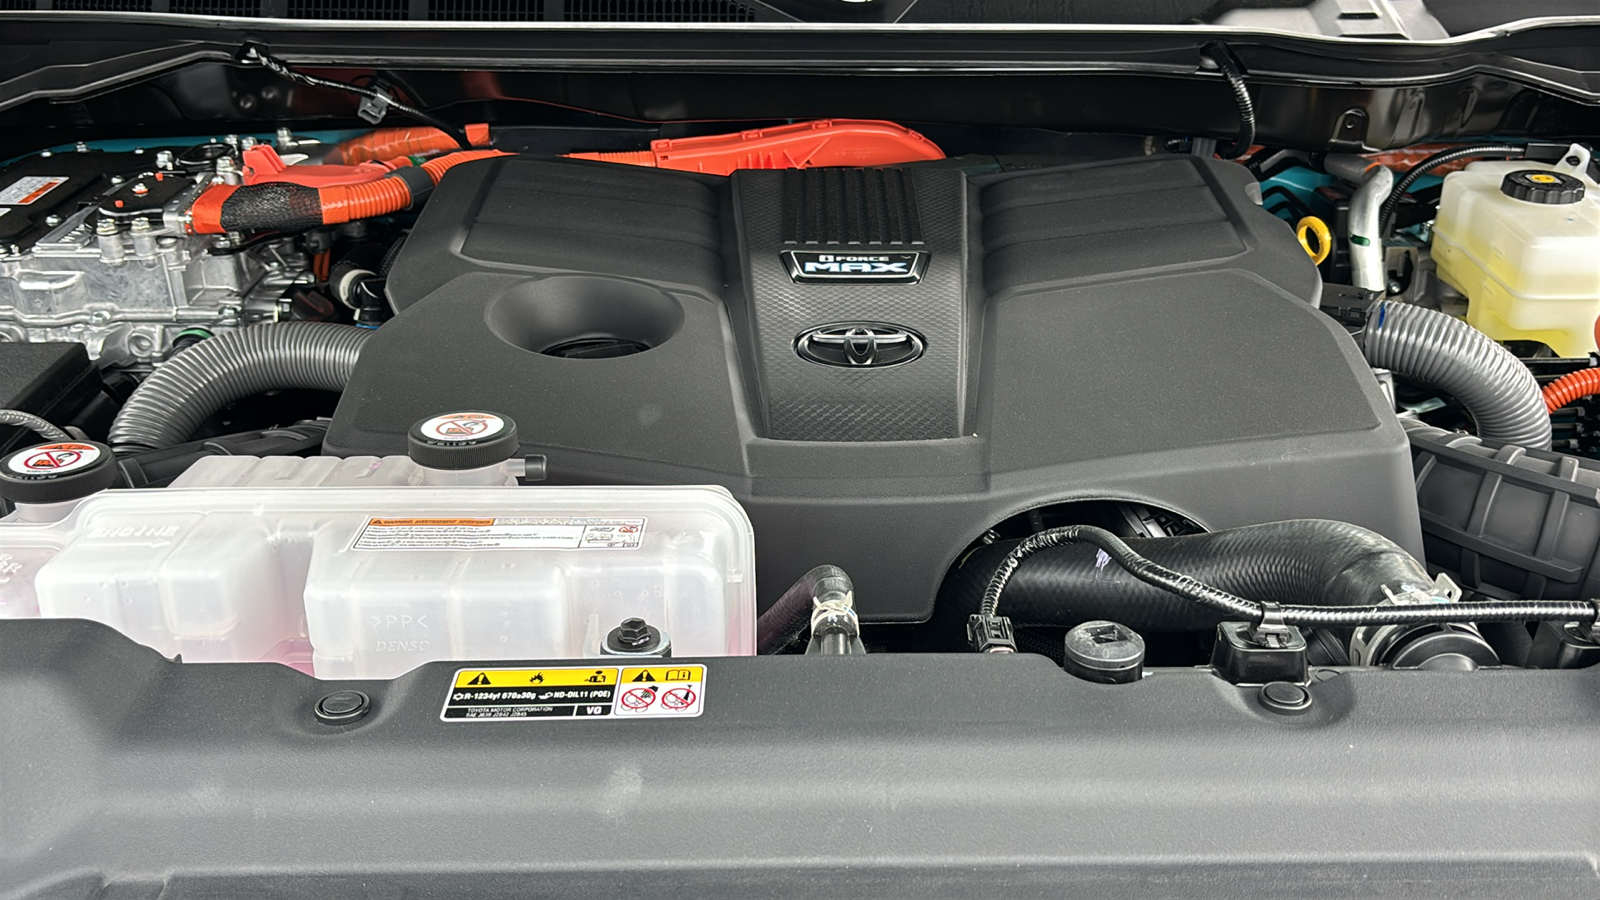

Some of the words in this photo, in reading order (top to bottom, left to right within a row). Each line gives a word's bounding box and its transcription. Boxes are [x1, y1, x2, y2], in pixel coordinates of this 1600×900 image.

[804, 262, 908, 273] MAX
[376, 640, 430, 652] DENSO
[589, 690, 611, 698] (POE)
